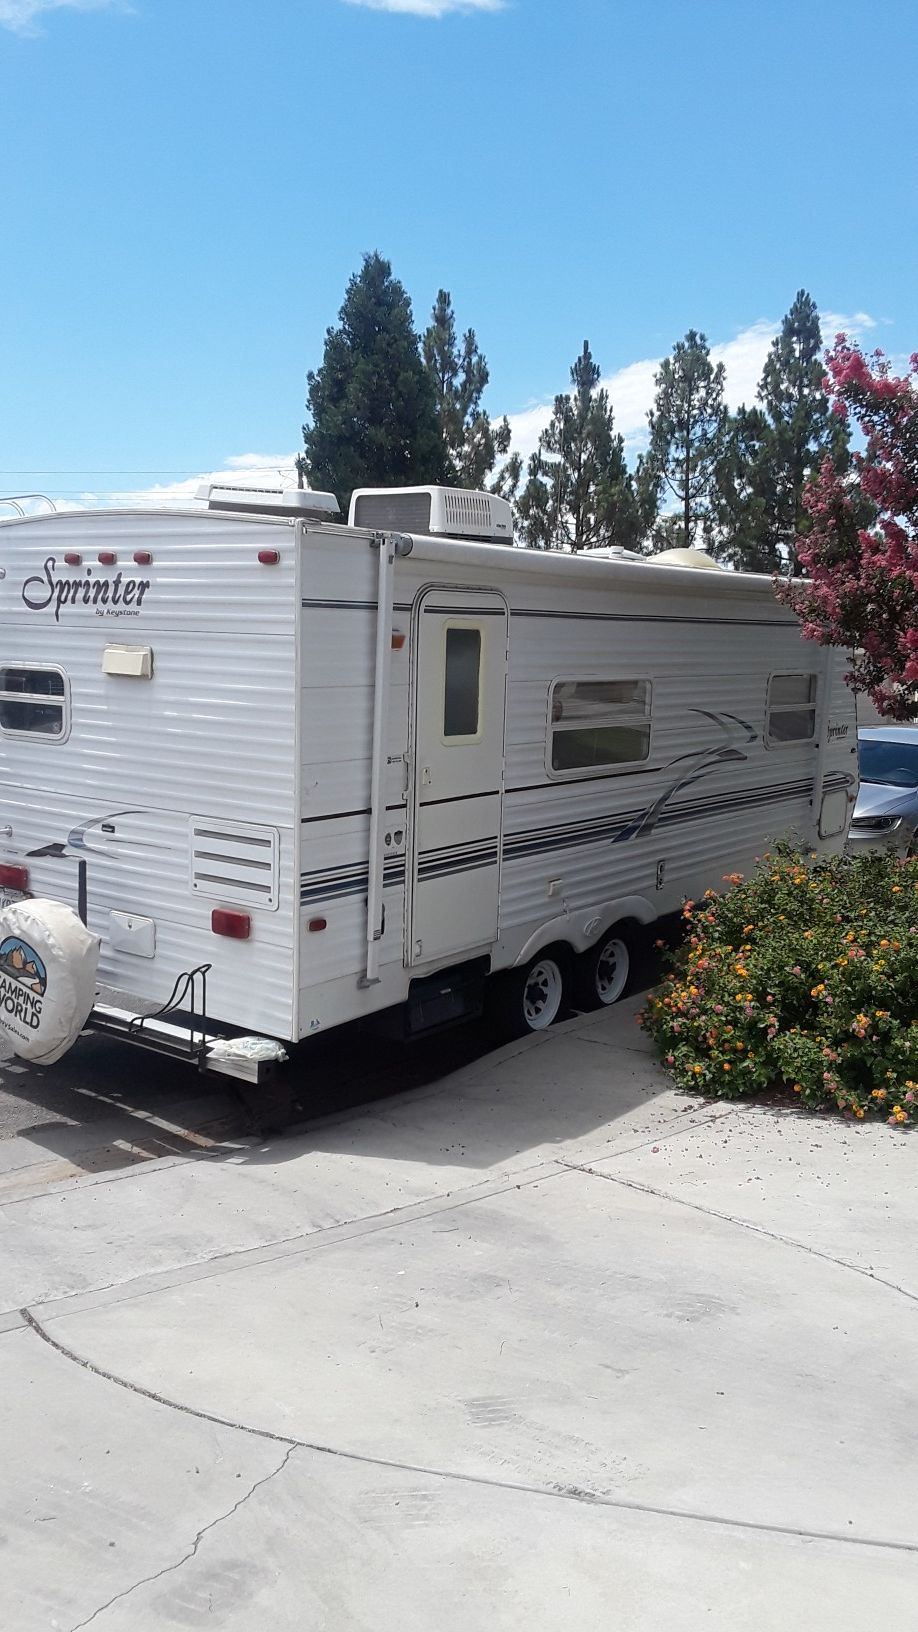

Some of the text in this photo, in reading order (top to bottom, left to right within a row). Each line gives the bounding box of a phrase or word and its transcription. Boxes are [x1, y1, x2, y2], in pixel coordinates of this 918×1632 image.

[22, 556, 150, 622] Sprinter
[95, 608, 140, 617] by Keystone
[0, 976, 43, 1014] AMPING
